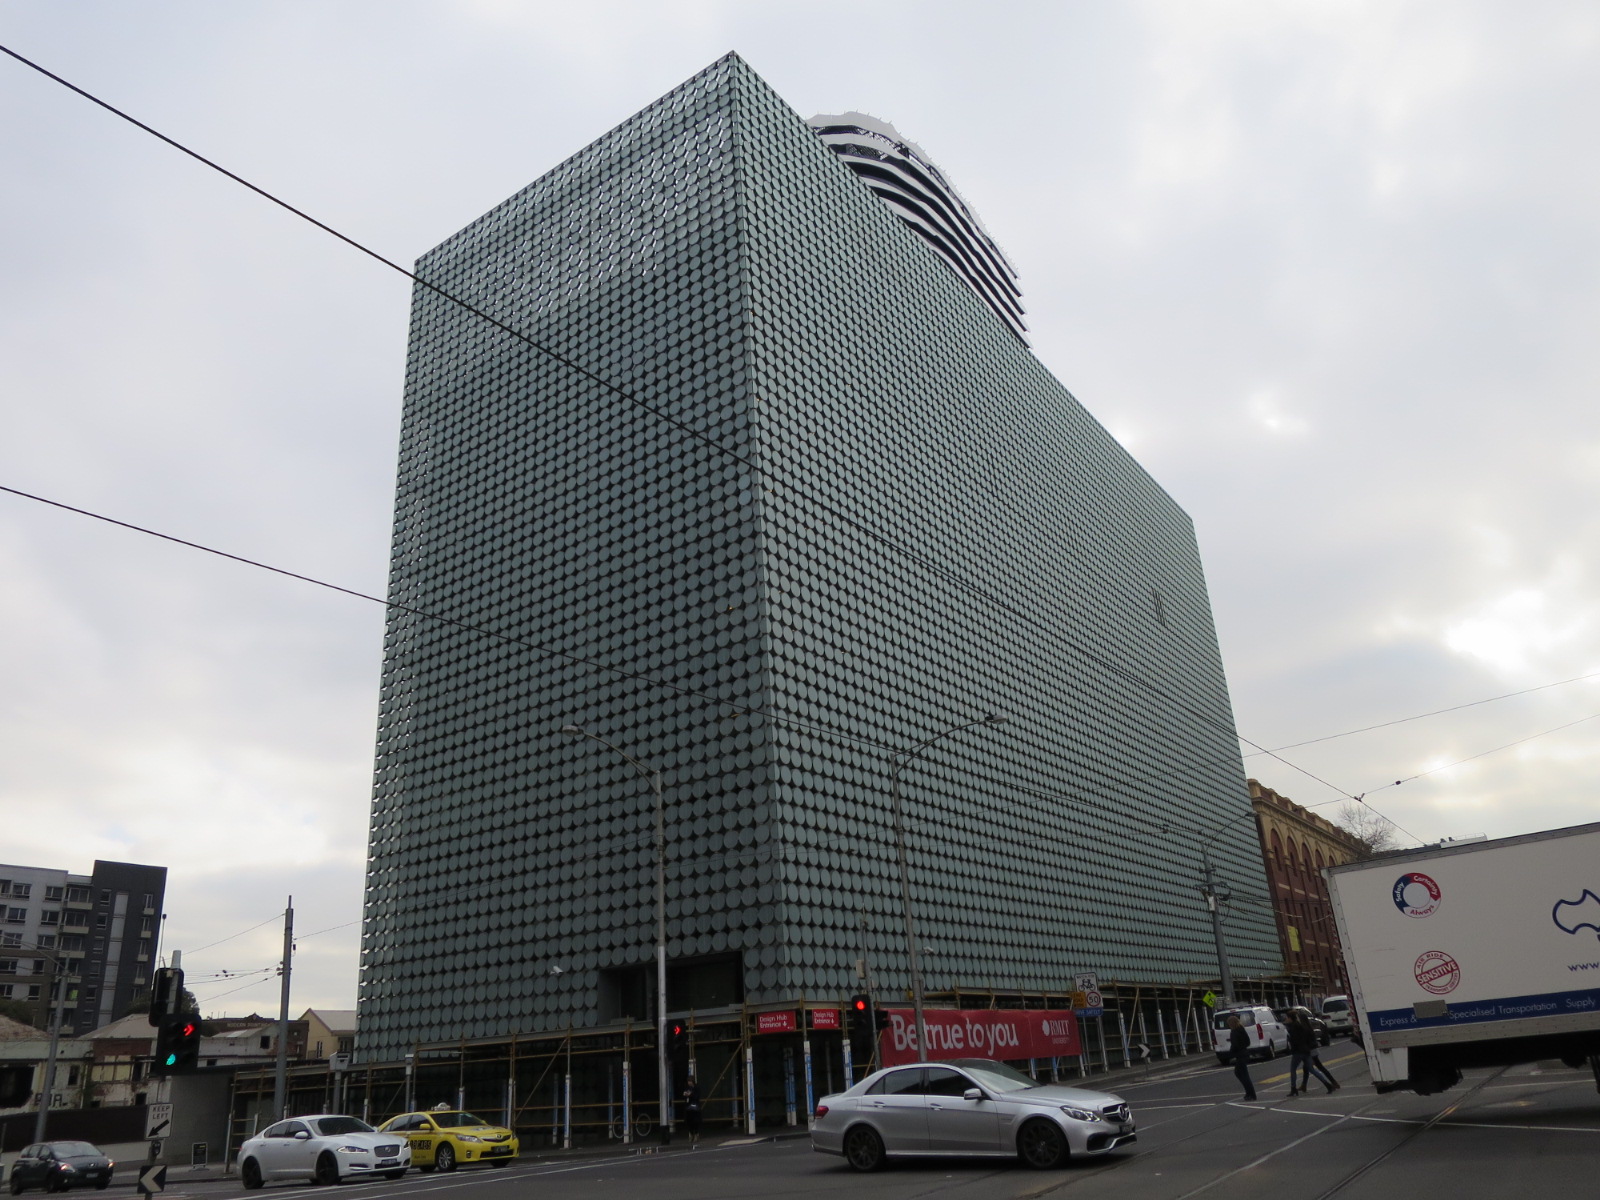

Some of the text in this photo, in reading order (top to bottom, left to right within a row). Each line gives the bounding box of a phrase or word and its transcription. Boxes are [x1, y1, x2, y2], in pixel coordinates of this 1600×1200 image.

[1394, 882, 1405, 902] Safety
[1413, 875, 1438, 896] Certainty
[1409, 904, 1435, 916] Always
[1416, 961, 1457, 984] SENSITIVE
[1380, 996, 1596, 1027] Express & Specialised Transportation Supply
[890, 1014, 1019, 1057] Be true to you
[1049, 1019, 1070, 1036] RMIT
[152, 1112, 169, 1120] LEFT
